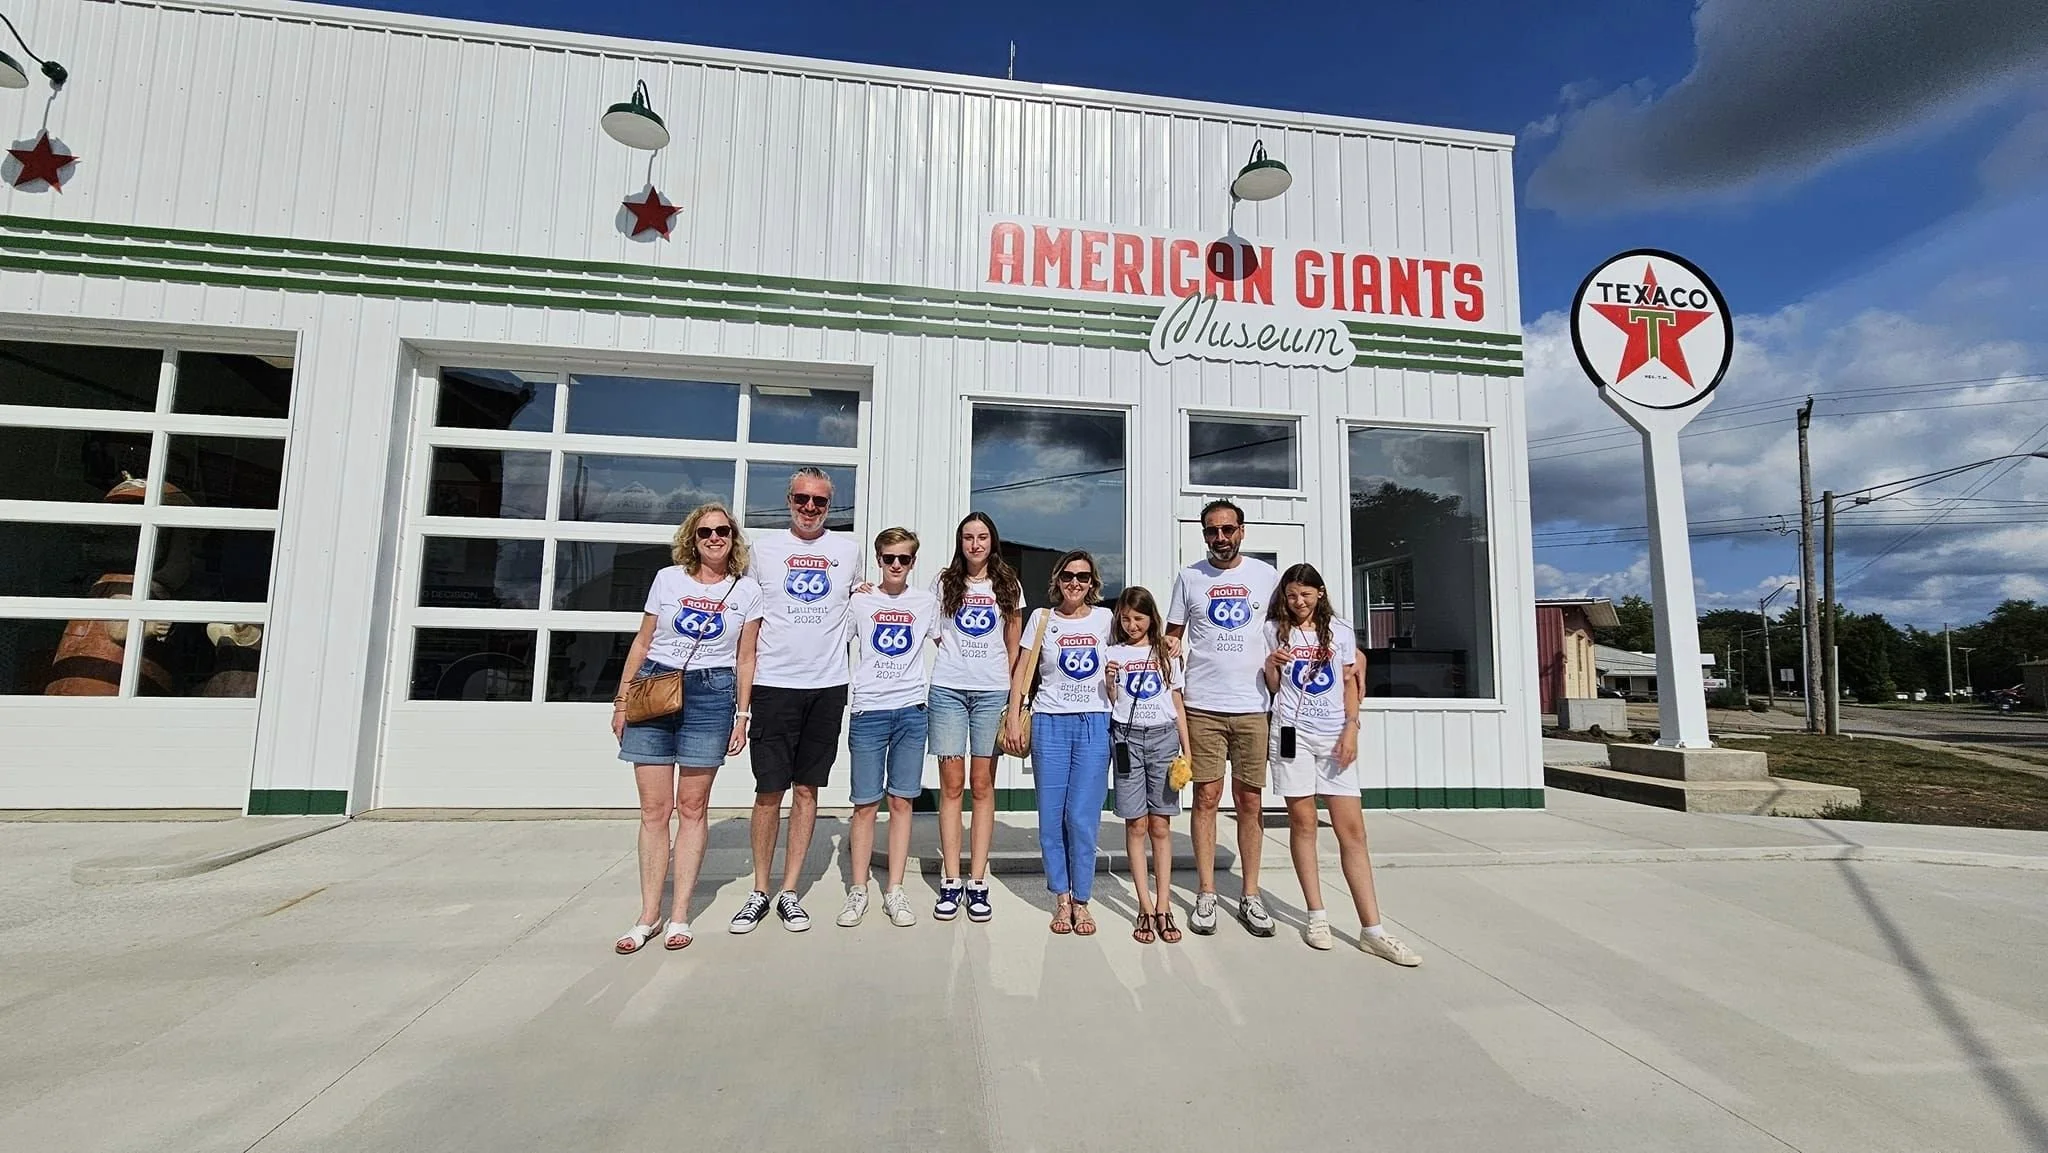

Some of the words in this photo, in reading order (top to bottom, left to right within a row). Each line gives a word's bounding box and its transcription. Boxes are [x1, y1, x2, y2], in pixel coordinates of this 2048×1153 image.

[986, 222, 1275, 305] AMERICAN
[1296, 249, 1485, 322] GIANTS
[1596, 282, 1708, 309] TEXACO
[1159, 292, 1345, 356] Museum
[793, 559, 825, 568] ROUTE
[792, 573, 824, 594] 66
[787, 605, 829, 615] Laurent
[1214, 601, 1245, 621] 66
[681, 612, 717, 634] 66
[794, 615, 822, 625] 2023
[879, 614, 910, 623] ROUTE
[961, 609, 990, 629] 66
[878, 627, 908, 649] 66
[1063, 638, 1094, 646] ROUTE
[1217, 633, 1244, 642] Alain
[961, 639, 989, 649] Diane
[1216, 643, 1244, 652] 2023
[671, 648, 702, 661] 203
[961, 649, 987, 658] 2023
[873, 660, 908, 670] Arthur
[1065, 650, 1095, 672] 66
[1129, 663, 1156, 671] ROUTE
[1060, 682, 1096, 694] Brigitte
[1130, 673, 1158, 694] 66
[1063, 693, 1091, 703] 2023
[1134, 711, 1157, 720] 2023
